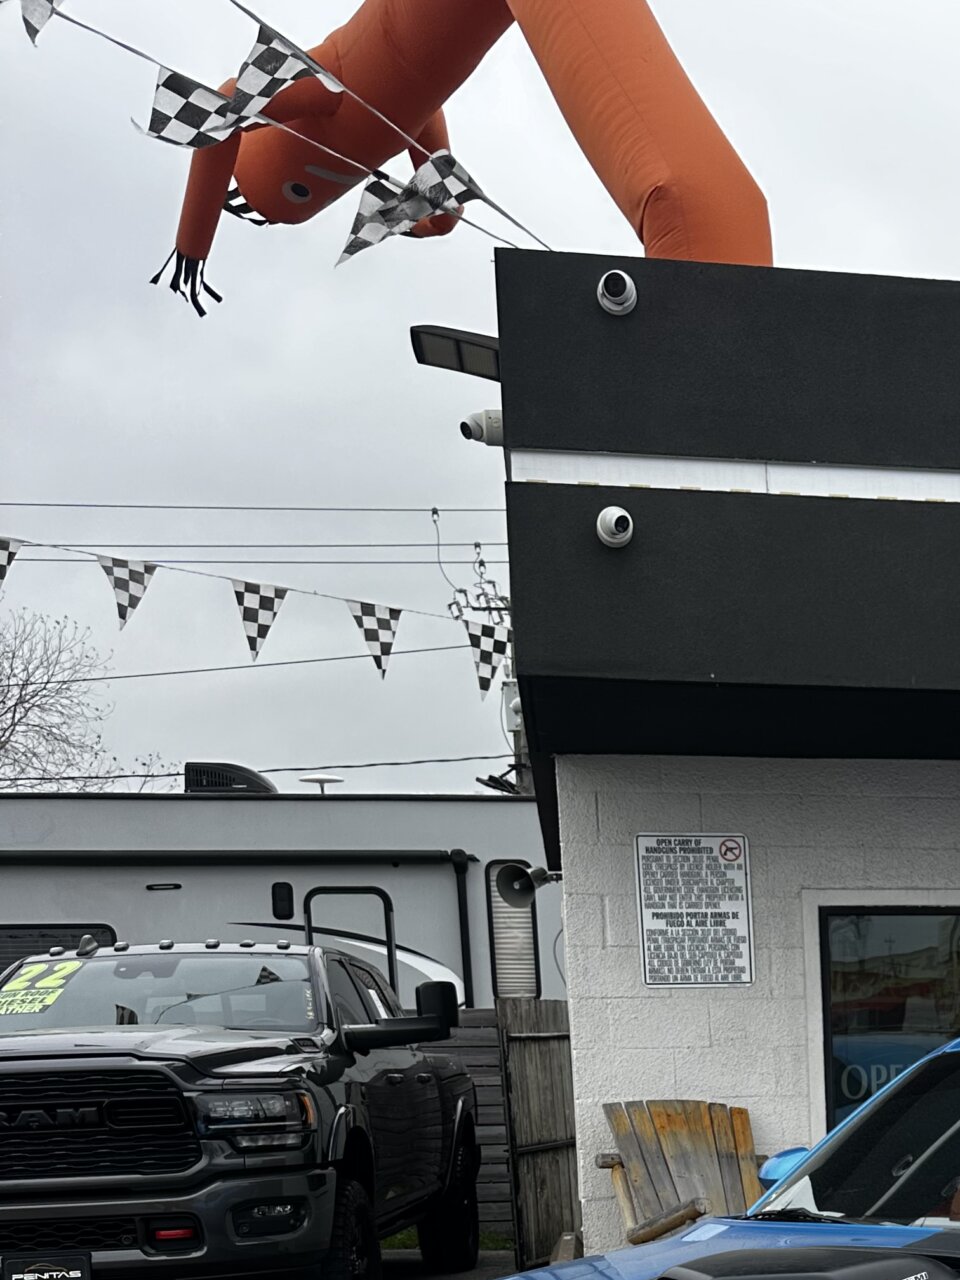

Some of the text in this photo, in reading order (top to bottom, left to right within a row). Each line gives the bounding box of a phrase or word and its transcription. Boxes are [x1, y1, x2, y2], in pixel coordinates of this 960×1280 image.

[656, 838, 702, 847] OPEN CARRY OF
[645, 847, 678, 855] HANDGUNS
[651, 911, 740, 920] PROHIBIDO PORTAR ARMAS DE
[666, 919, 685, 928] FUEGO
[710, 919, 727, 927] LIBRE
[1, 961, 83, 991] 22
[0, 996, 47, 1006] IESEL
[0, 1106, 98, 1128] AM
[12, 1270, 82, 1280] PENITAS
